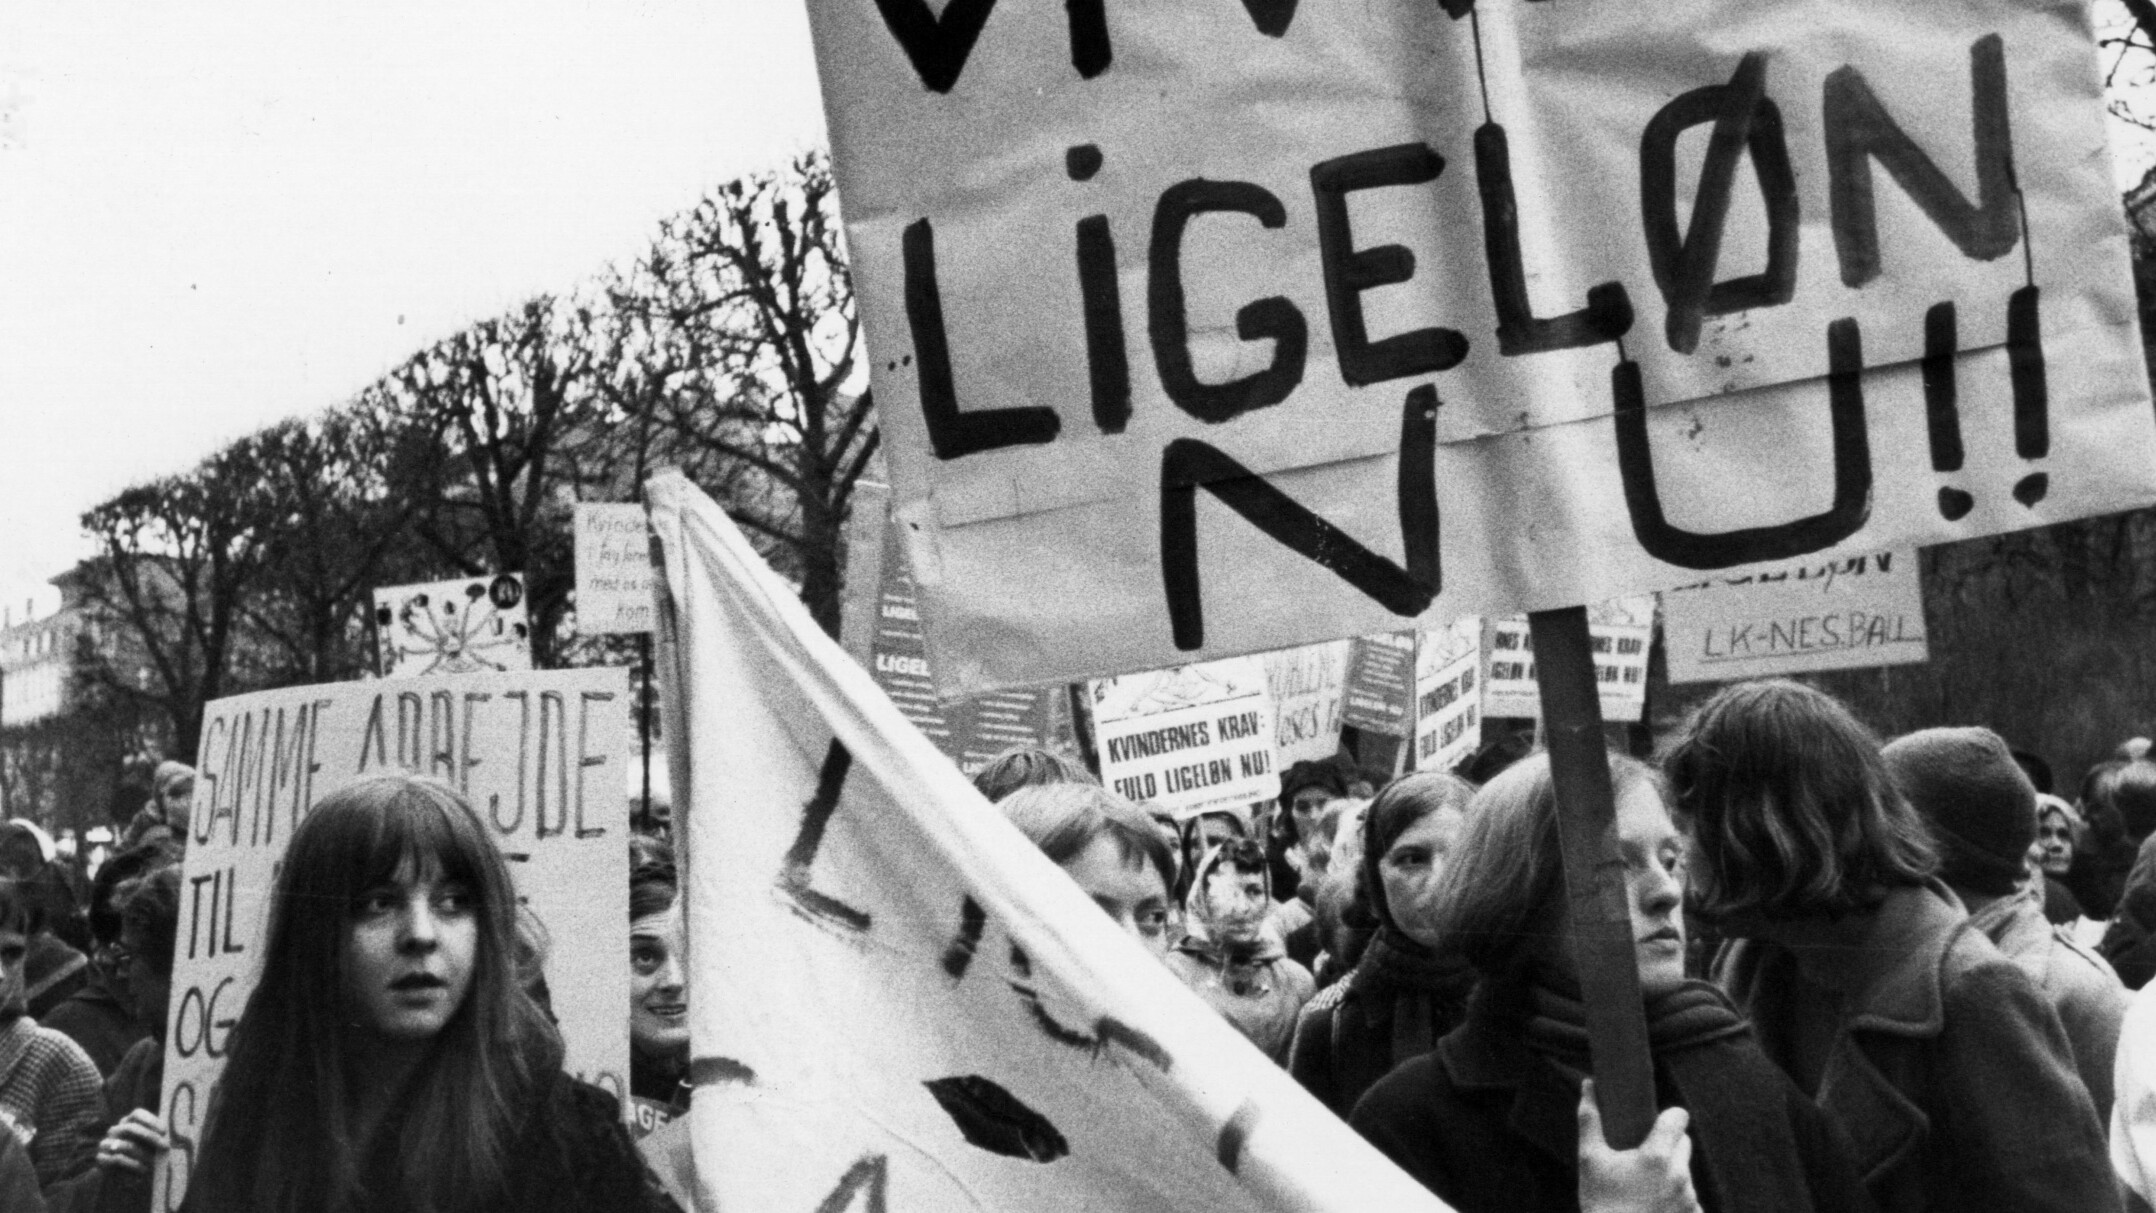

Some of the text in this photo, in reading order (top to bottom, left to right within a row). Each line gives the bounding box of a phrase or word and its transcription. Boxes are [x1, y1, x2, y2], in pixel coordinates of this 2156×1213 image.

[876, 653, 931, 677] LIGEL
[1107, 720, 1211, 764] KVINDERNES
[1217, 711, 1266, 743] KRAV:
[1113, 772, 1158, 802] FULD
[1164, 756, 1233, 794] LIGELØN
[1239, 749, 1272, 779] NU!
[189, 866, 243, 960] TIL
[175, 976, 236, 1059] OG
